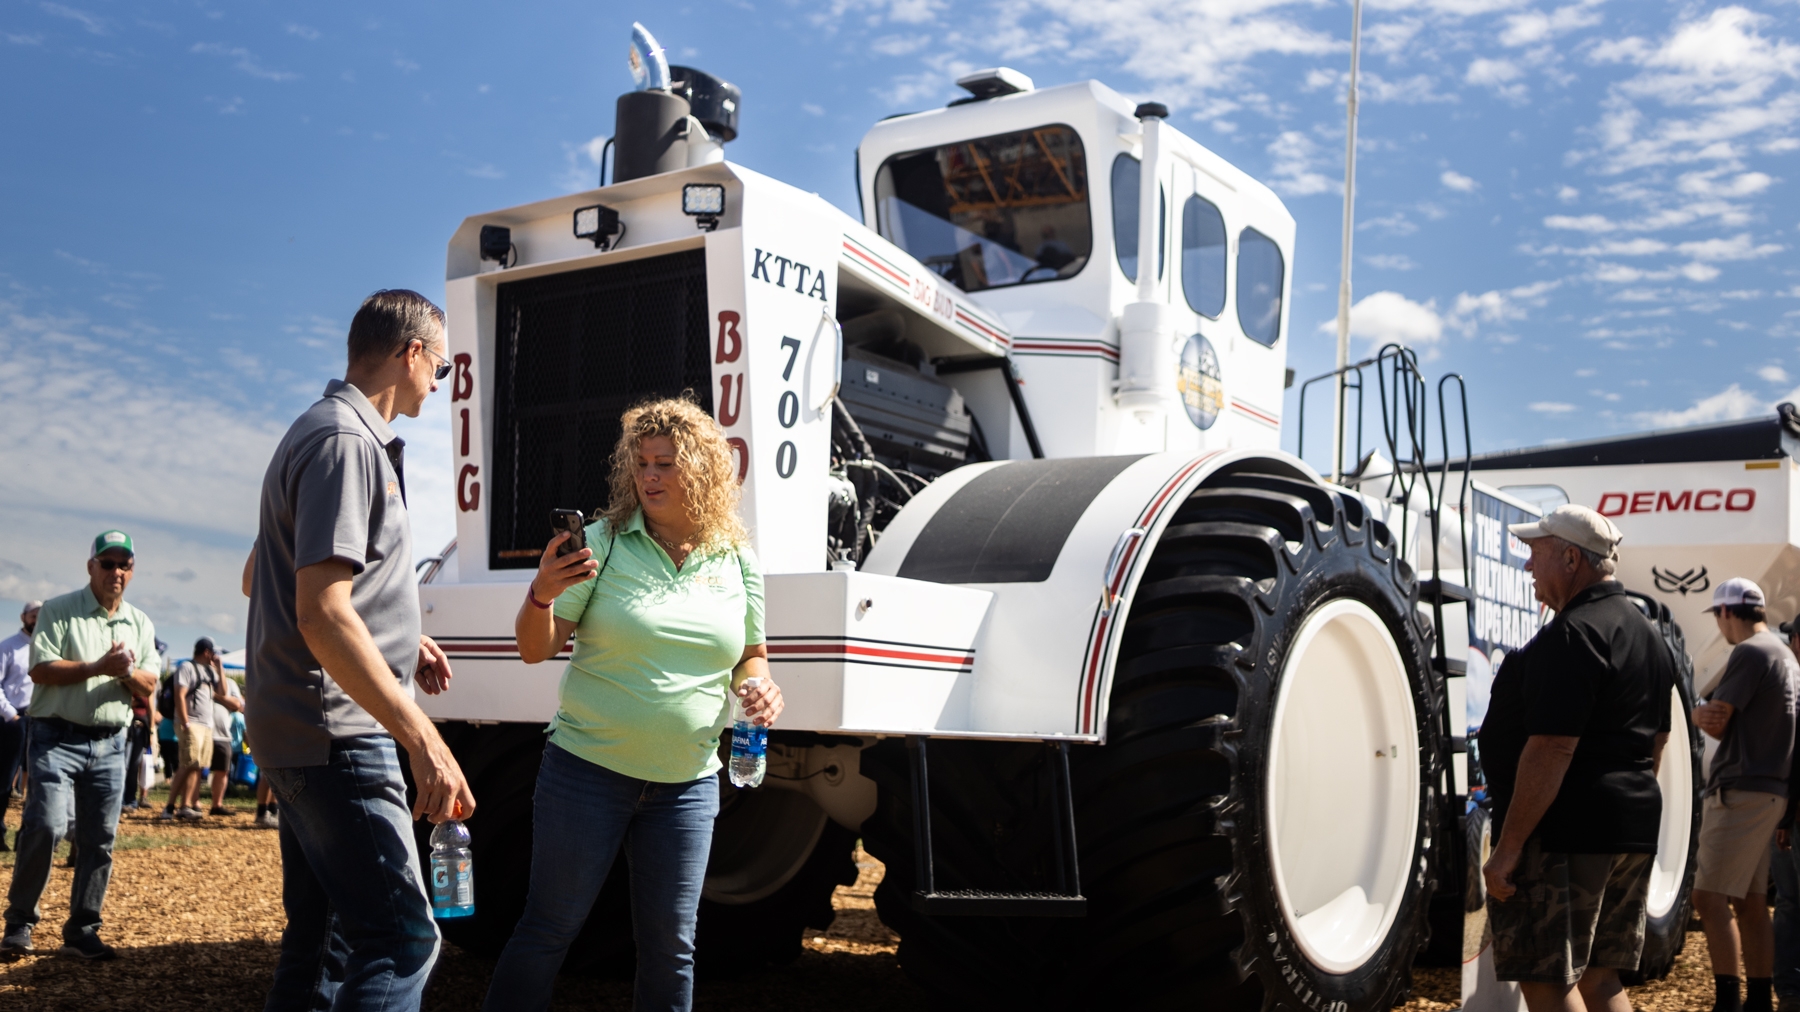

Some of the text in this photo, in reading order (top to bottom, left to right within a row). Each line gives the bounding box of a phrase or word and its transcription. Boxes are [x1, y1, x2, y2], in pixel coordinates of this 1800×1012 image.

[752, 248, 828, 302] KTTA
[913, 277, 954, 319] BIG BUD
[452, 352, 480, 512] BIG
[1596, 488, 1757, 517] DEMCO
[1475, 512, 1501, 561] THE
[433, 866, 449, 888] G
